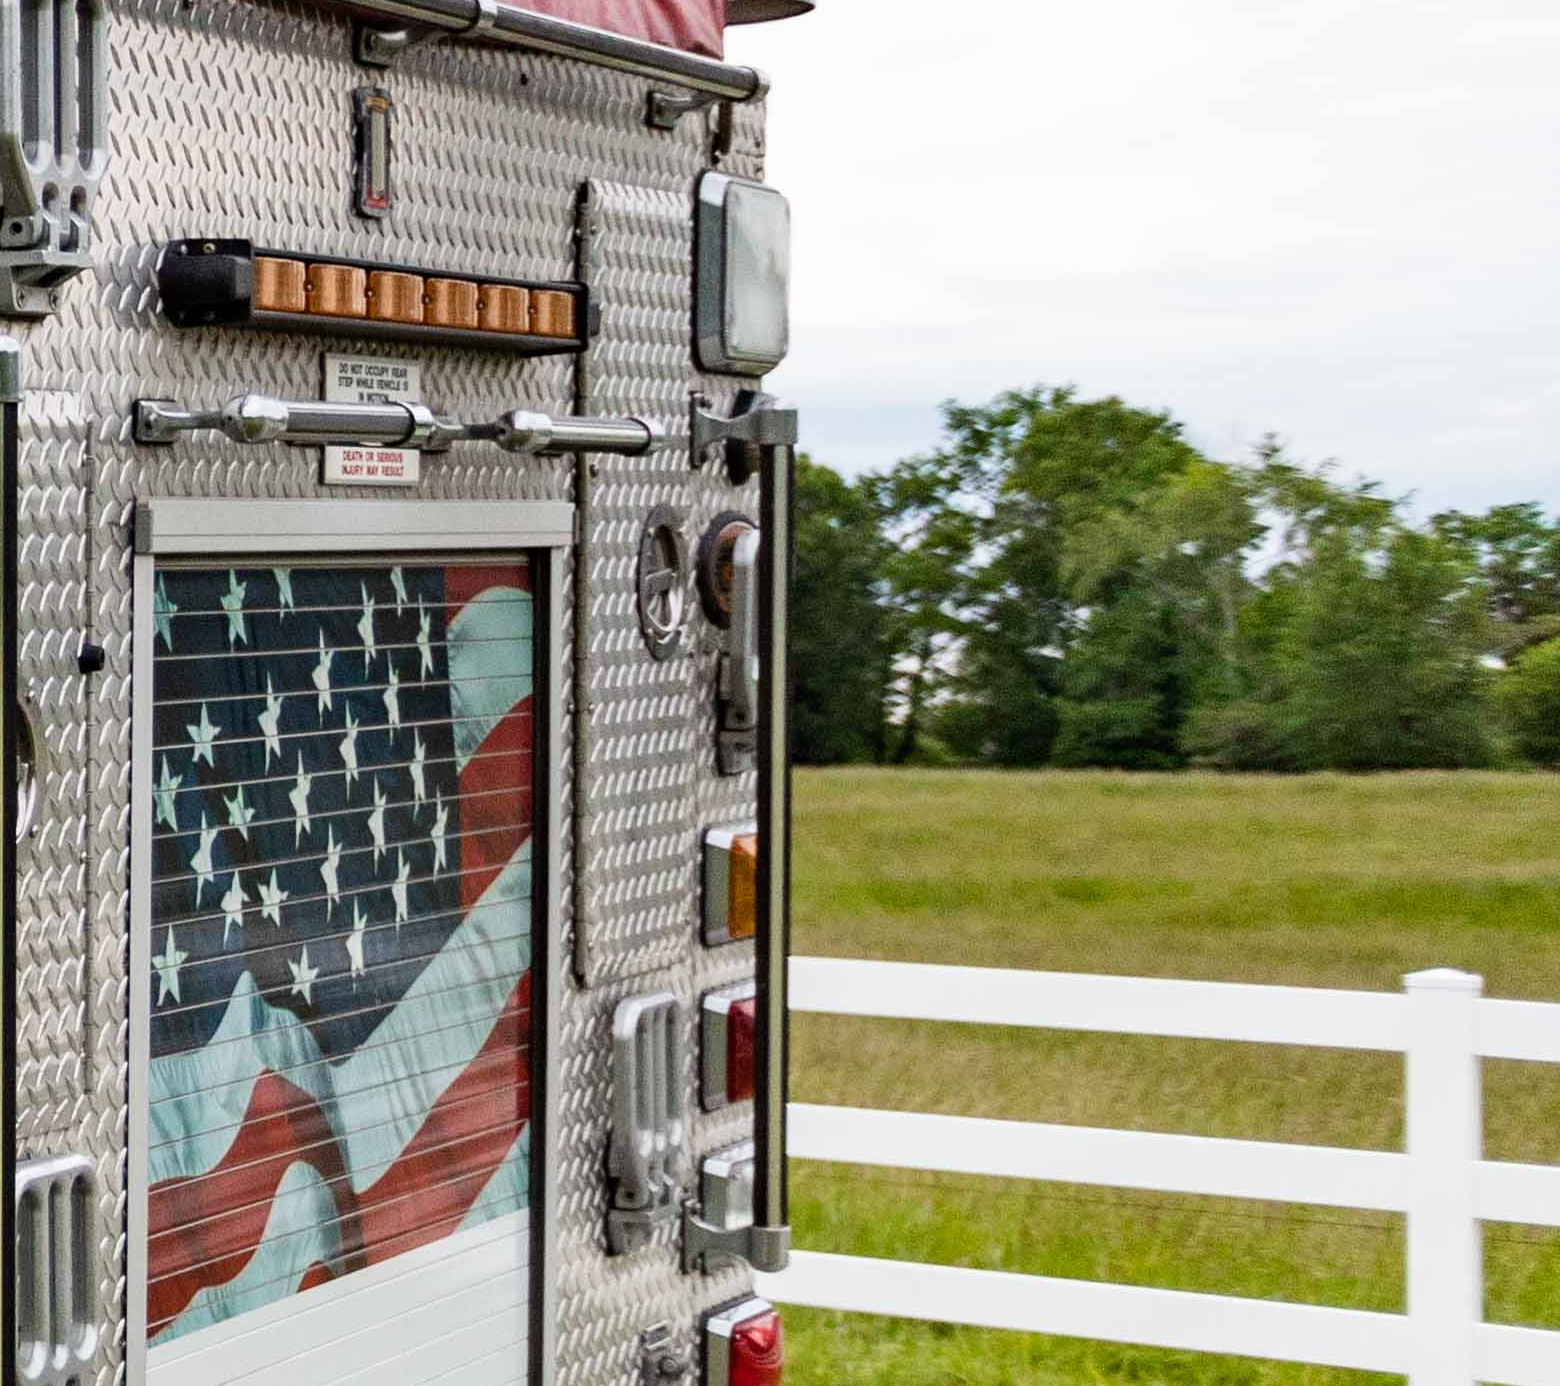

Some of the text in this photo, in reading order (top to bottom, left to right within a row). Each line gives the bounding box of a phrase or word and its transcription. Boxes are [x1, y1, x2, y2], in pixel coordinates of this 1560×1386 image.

[339, 363, 349, 373] DO
[350, 364, 362, 374] NOT
[365, 365, 389, 376] OCCUPY
[338, 376, 353, 387] STEP
[356, 378, 373, 389] WHILE
[377, 379, 400, 391] VEHICLE
[343, 450, 403, 463] DEATH OR SERIOUS
[342, 465, 404, 477] INJURY MAY RESULT
